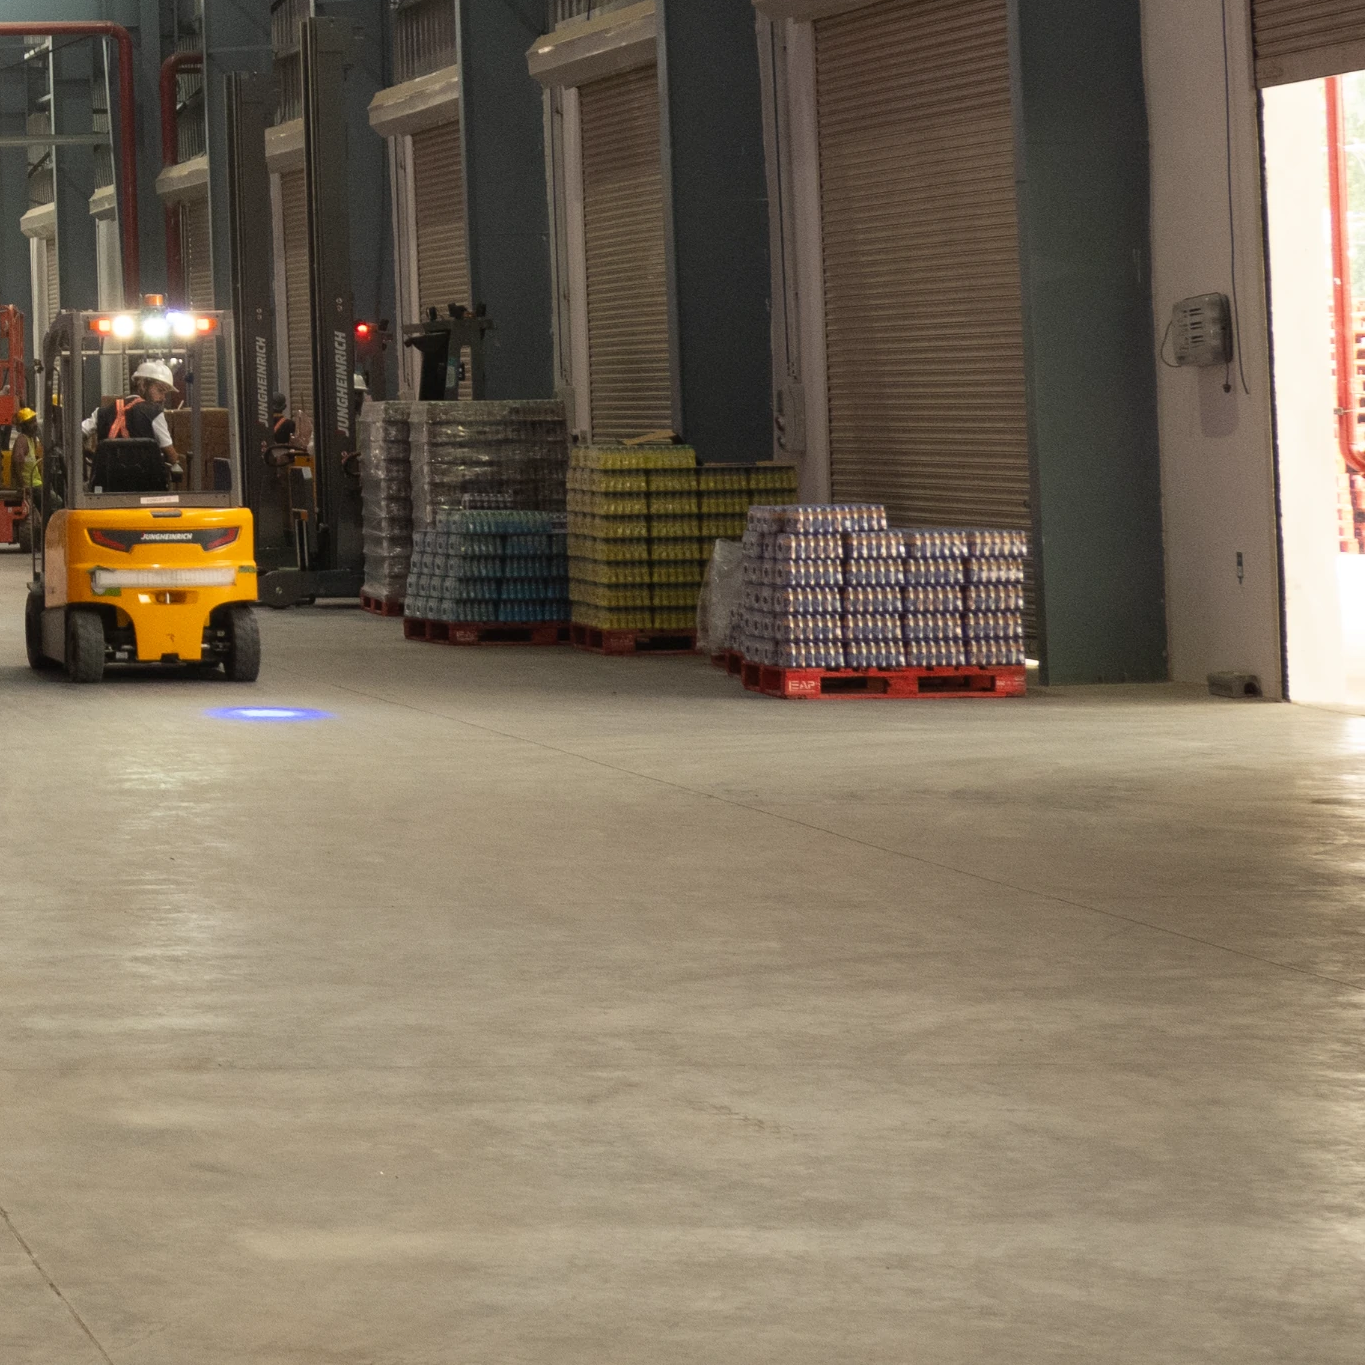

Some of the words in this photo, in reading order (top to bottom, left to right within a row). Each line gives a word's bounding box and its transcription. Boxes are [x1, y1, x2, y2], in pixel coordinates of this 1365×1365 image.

[255, 336, 268, 427] JUNGHEINRICH
[334, 331, 349, 437] JUNGHEINRICH
[141, 532, 193, 540] JUNGHEINRICH
[788, 680, 815, 692] EAP
